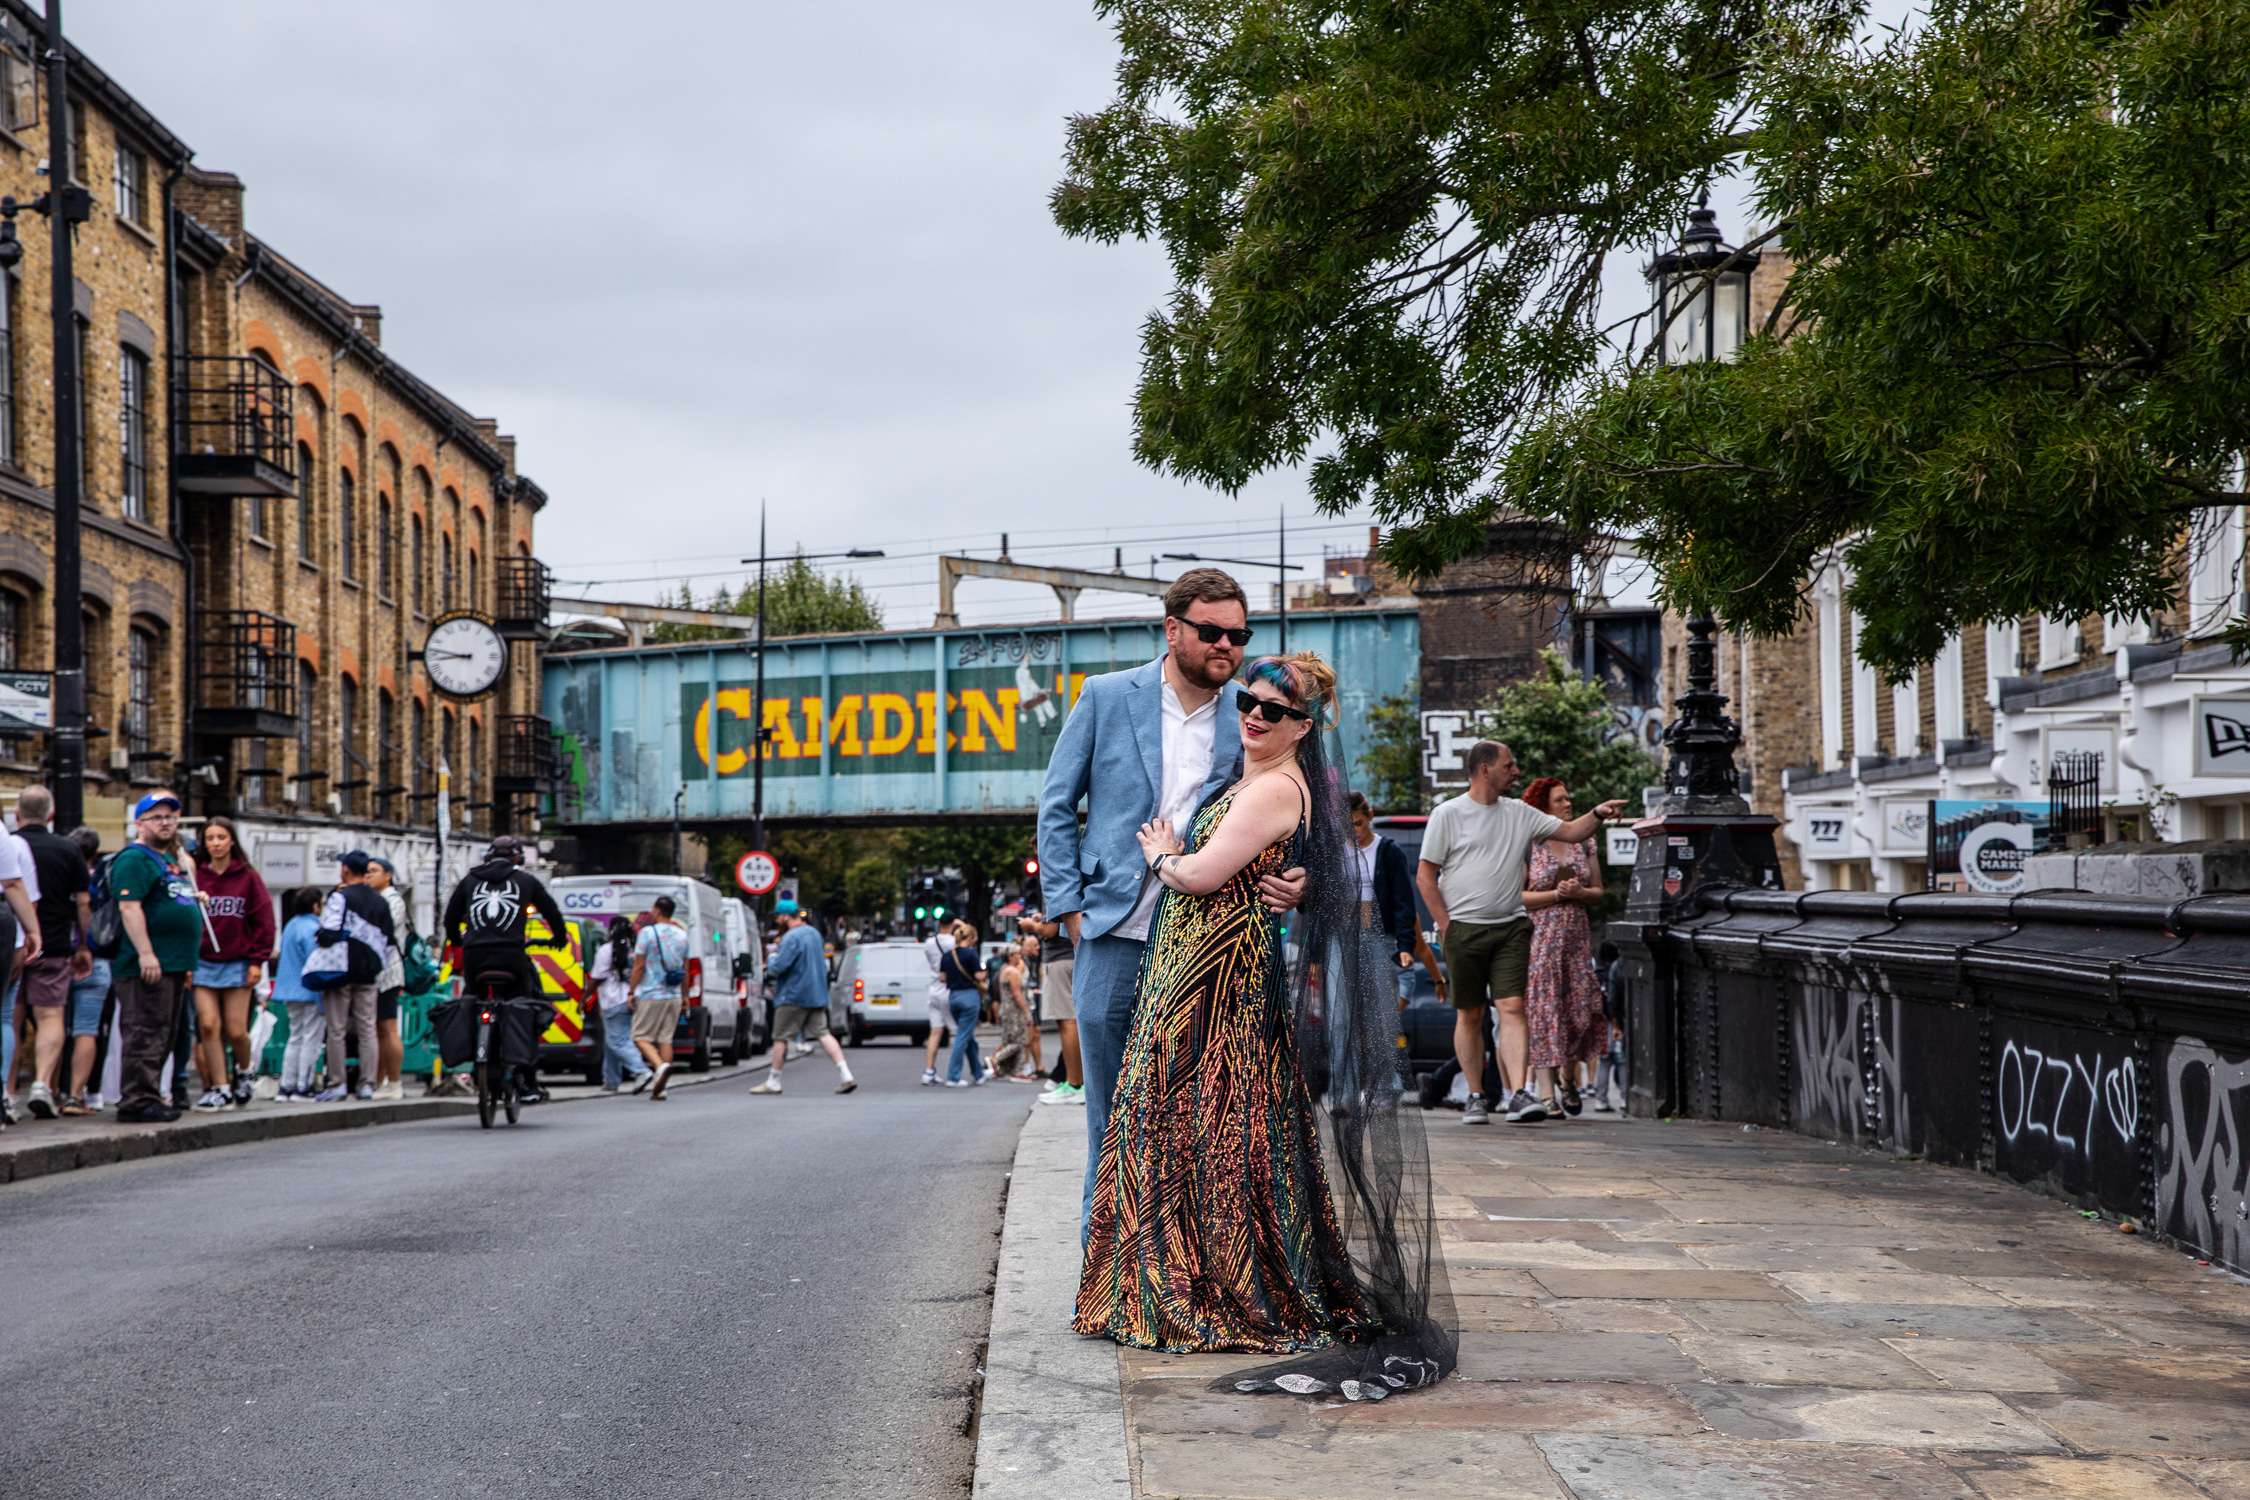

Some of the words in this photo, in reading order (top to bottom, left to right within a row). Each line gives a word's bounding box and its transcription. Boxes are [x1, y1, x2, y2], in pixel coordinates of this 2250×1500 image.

[693, 687, 1020, 775] CAMDEN
[1811, 821, 1843, 835] 777
[1980, 860, 2025, 870] MARKE
[564, 893, 603, 909] GSG
[2000, 1039, 2101, 1158] OZZY
